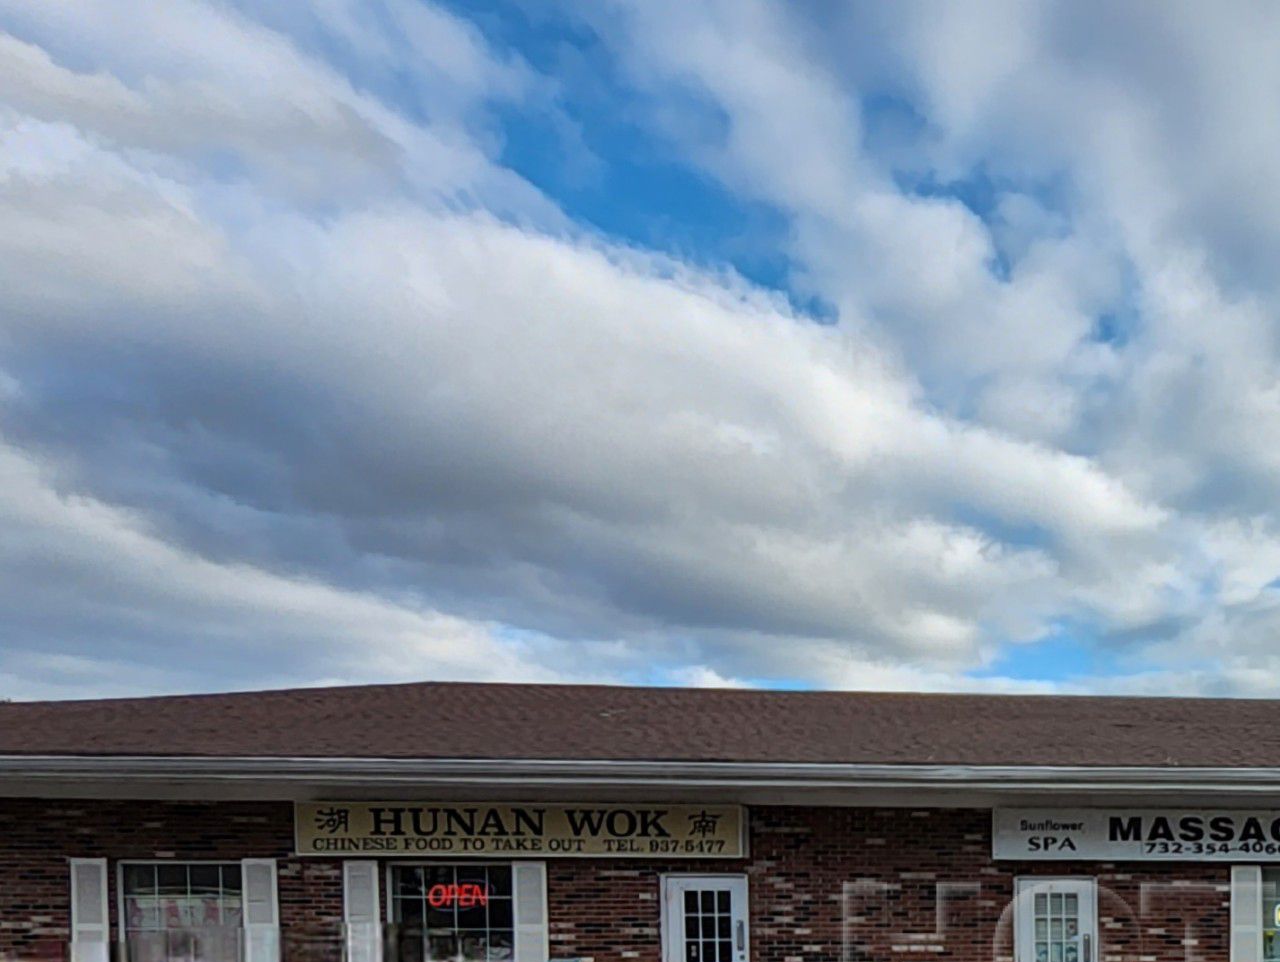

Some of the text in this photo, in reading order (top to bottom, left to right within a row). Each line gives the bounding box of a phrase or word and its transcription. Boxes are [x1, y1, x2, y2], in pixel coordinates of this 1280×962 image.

[314, 807, 349, 834] 湖
[368, 808, 671, 837] HUNAN WOK
[687, 810, 723, 838] 南
[1020, 819, 1084, 832] Sunflower
[312, 837, 398, 851] CHINESE
[404, 837, 453, 851] FOOD
[460, 838, 485, 851] TO
[491, 838, 542, 851] TAKE
[548, 838, 585, 851] OUT
[603, 839, 644, 852] TEL.
[1027, 836, 1077, 851] SPA
[428, 884, 487, 907] OPEN
